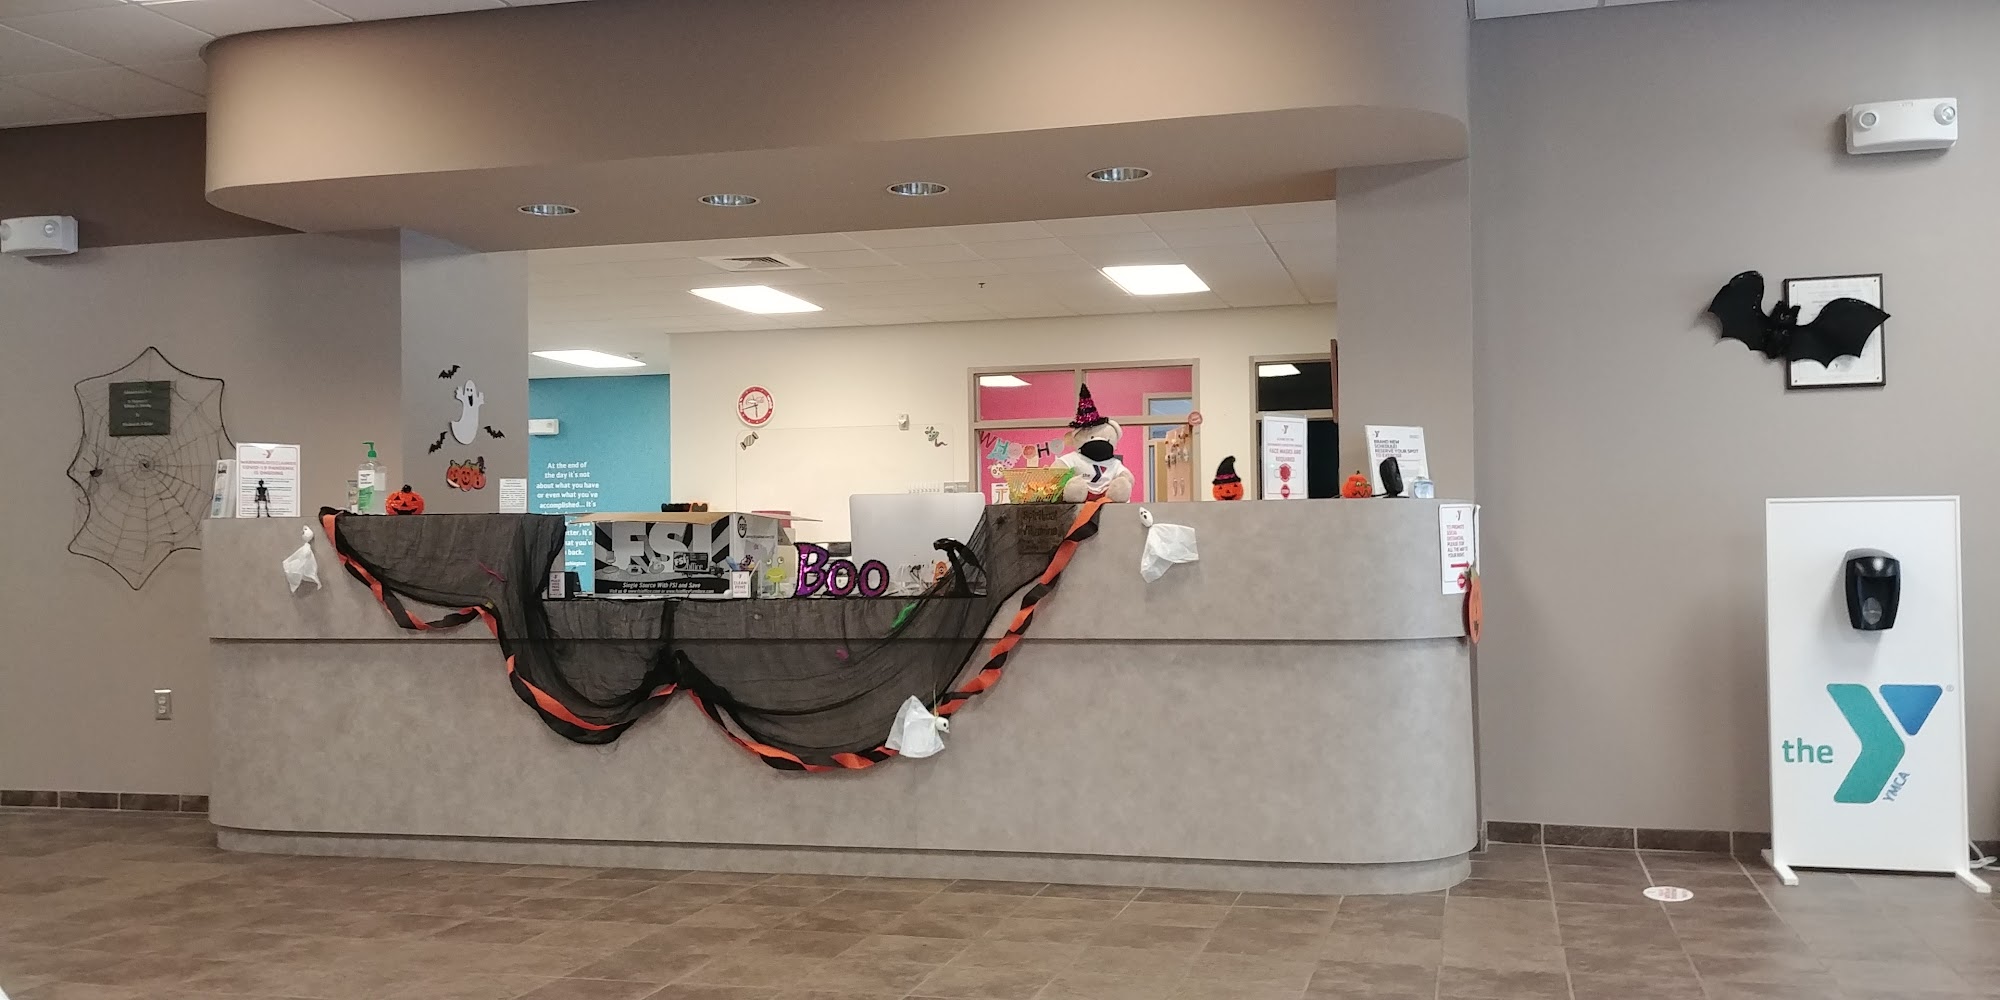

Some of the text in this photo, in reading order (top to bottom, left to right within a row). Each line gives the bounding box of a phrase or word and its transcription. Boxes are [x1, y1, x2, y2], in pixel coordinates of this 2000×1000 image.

[612, 522, 712, 573] FSI
[1782, 737, 1834, 764] the
[1882, 772, 1910, 802] YMCA
